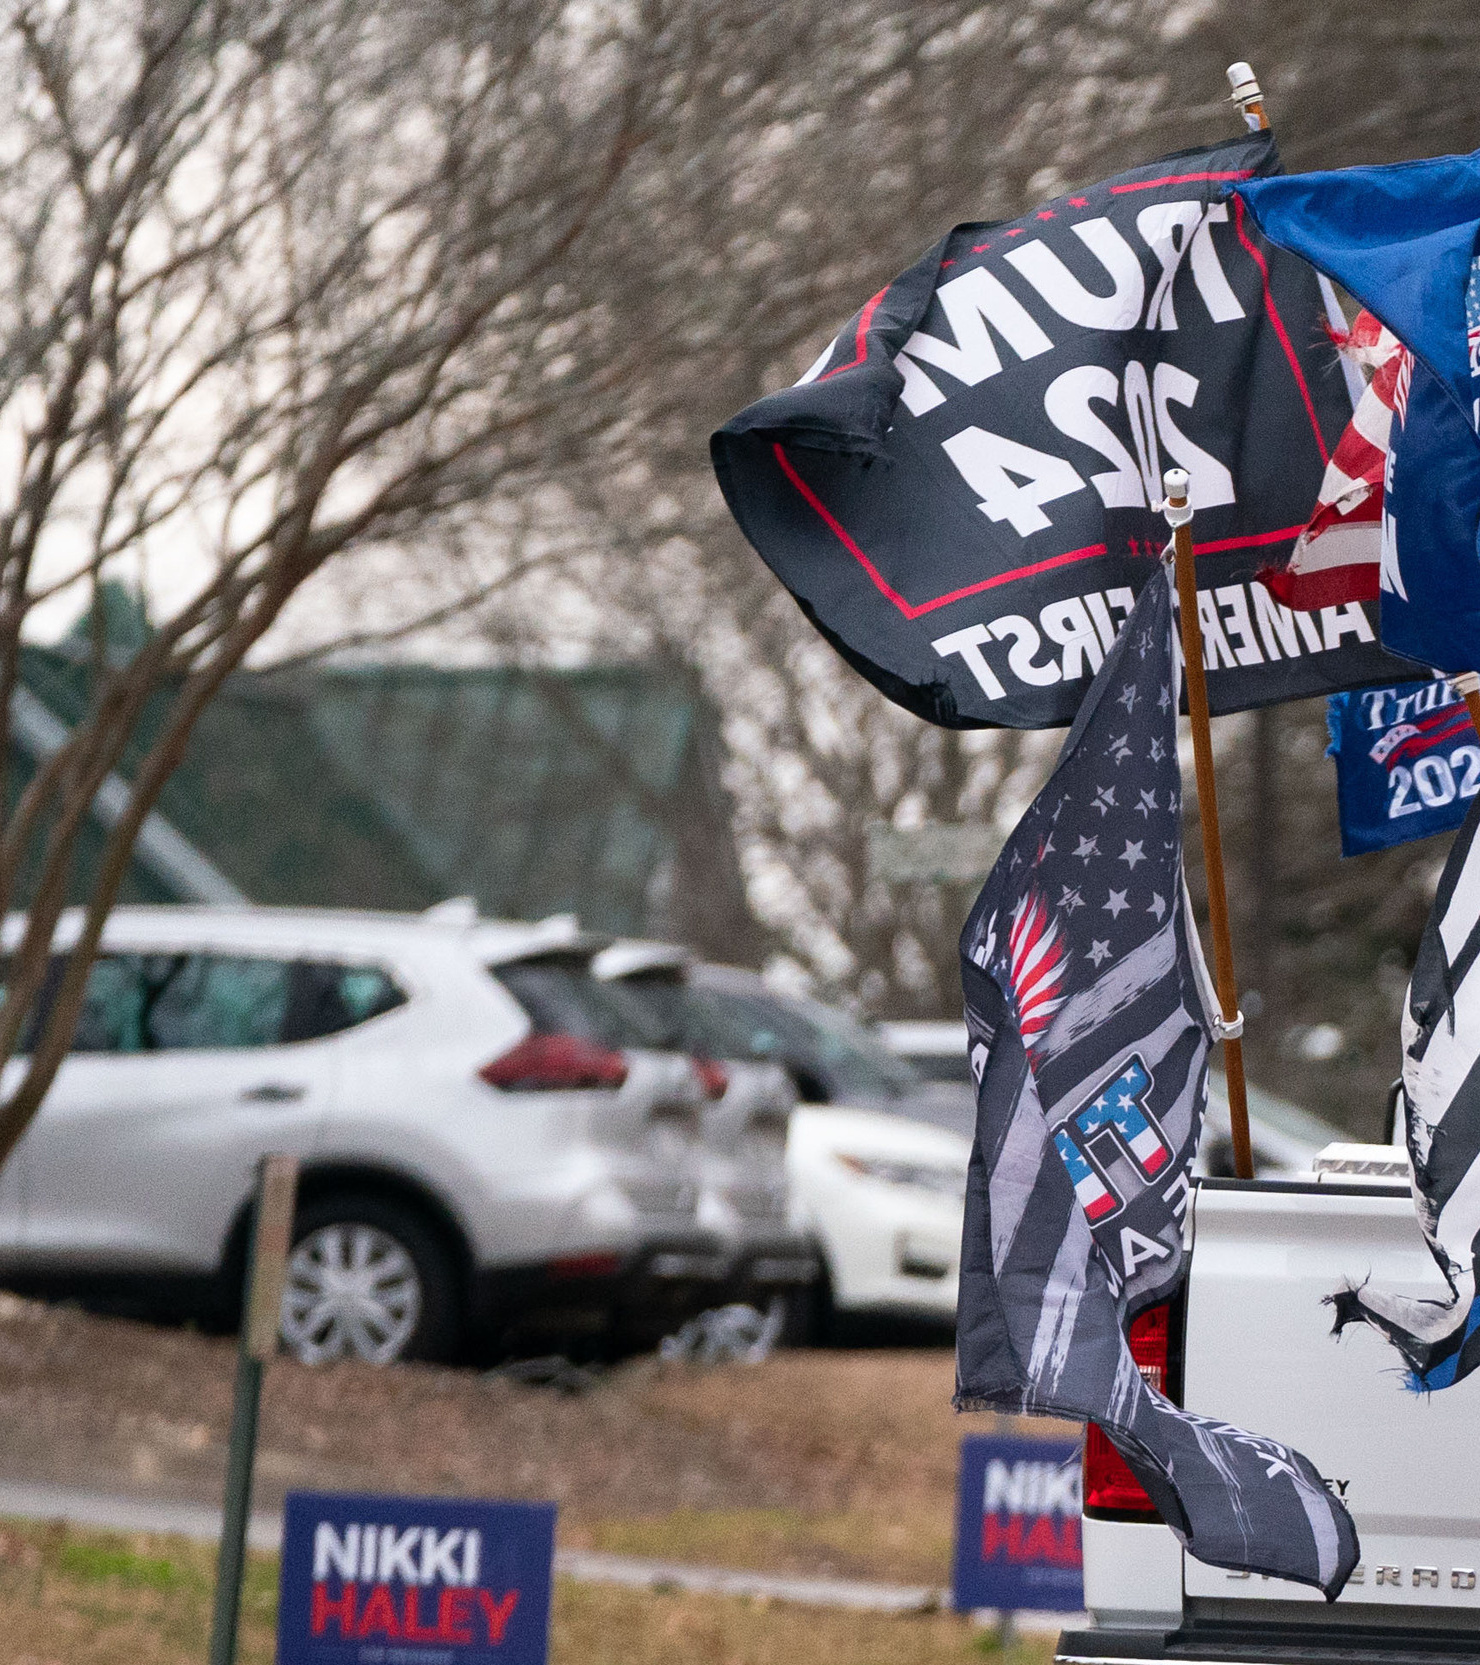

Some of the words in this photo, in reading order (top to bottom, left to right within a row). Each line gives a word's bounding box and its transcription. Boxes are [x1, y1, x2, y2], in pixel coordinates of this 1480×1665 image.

[983, 1459, 1083, 1515] NIK
[313, 1522, 481, 1587] NIKKI
[981, 1512, 1083, 1570] HAL
[311, 1581, 519, 1645] HALEY
